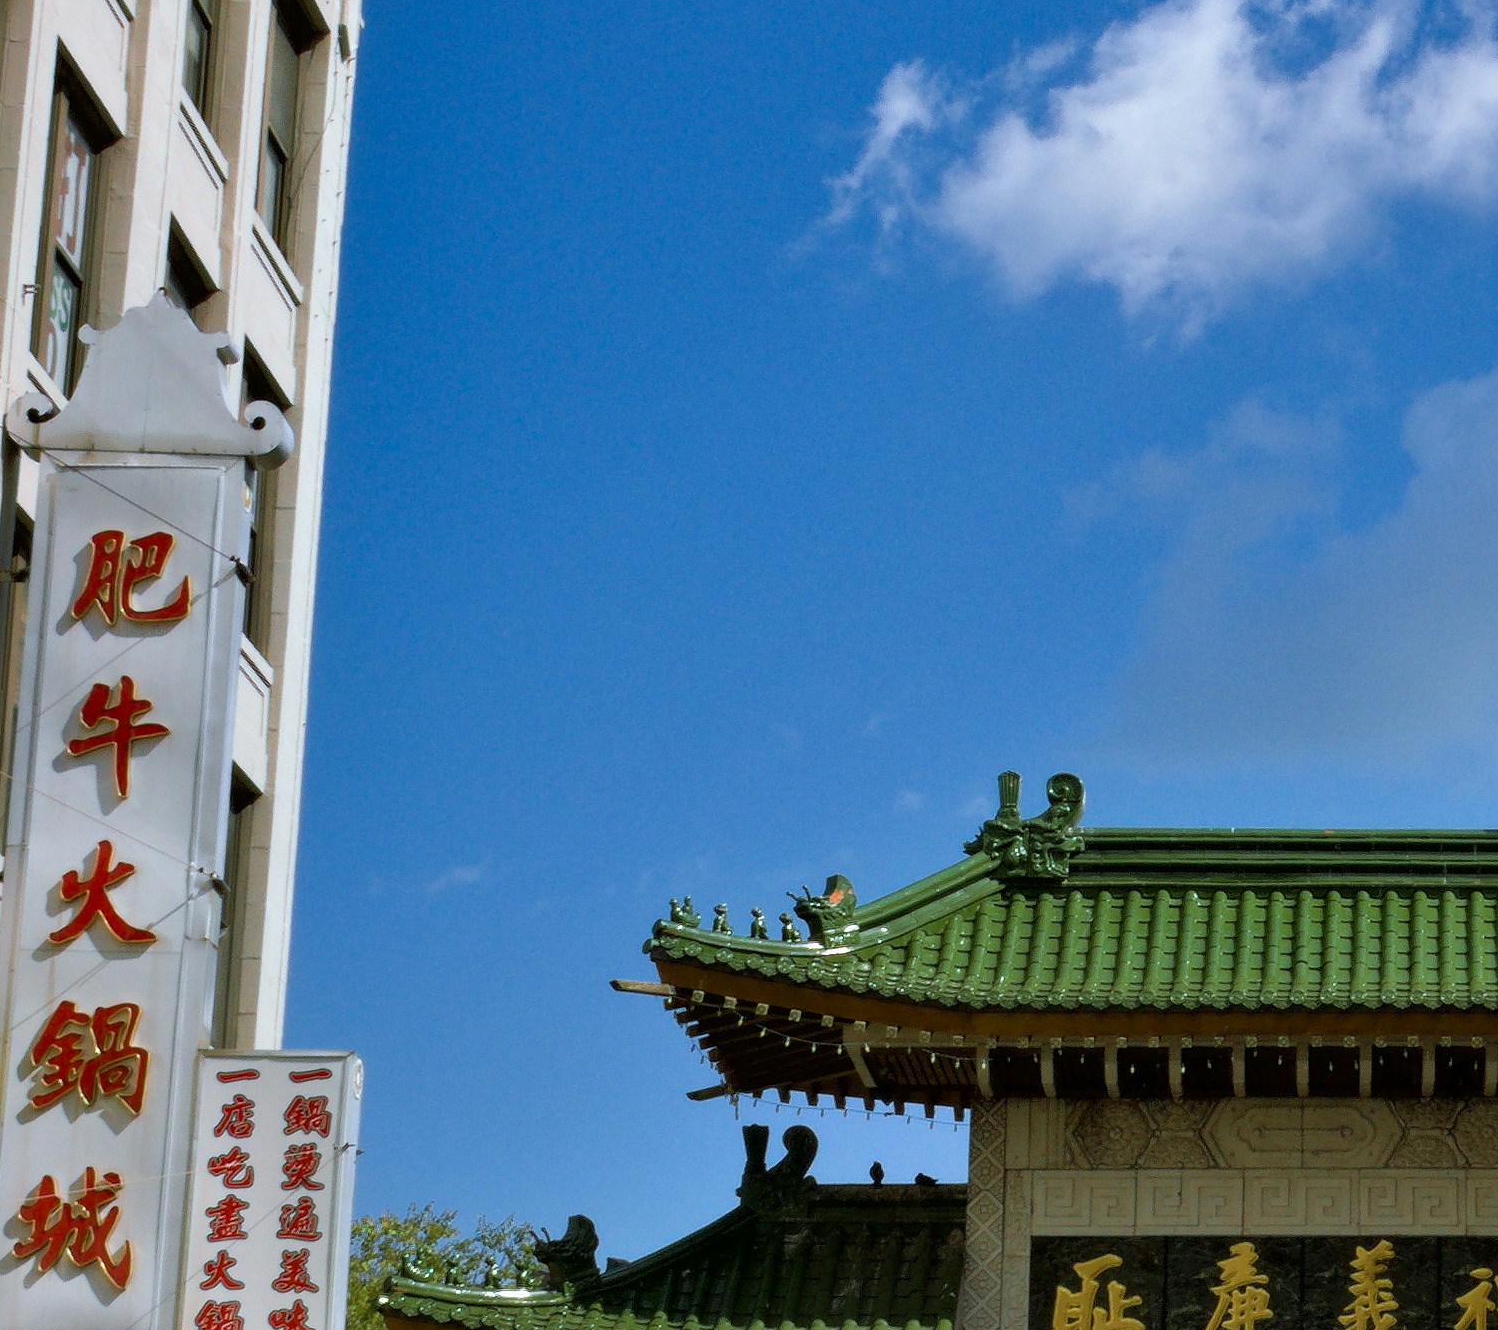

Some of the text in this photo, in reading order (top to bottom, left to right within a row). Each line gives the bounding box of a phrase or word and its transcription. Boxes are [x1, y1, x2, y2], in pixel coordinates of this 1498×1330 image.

[13, 527, 192, 1295] 肥牛火鍋城
